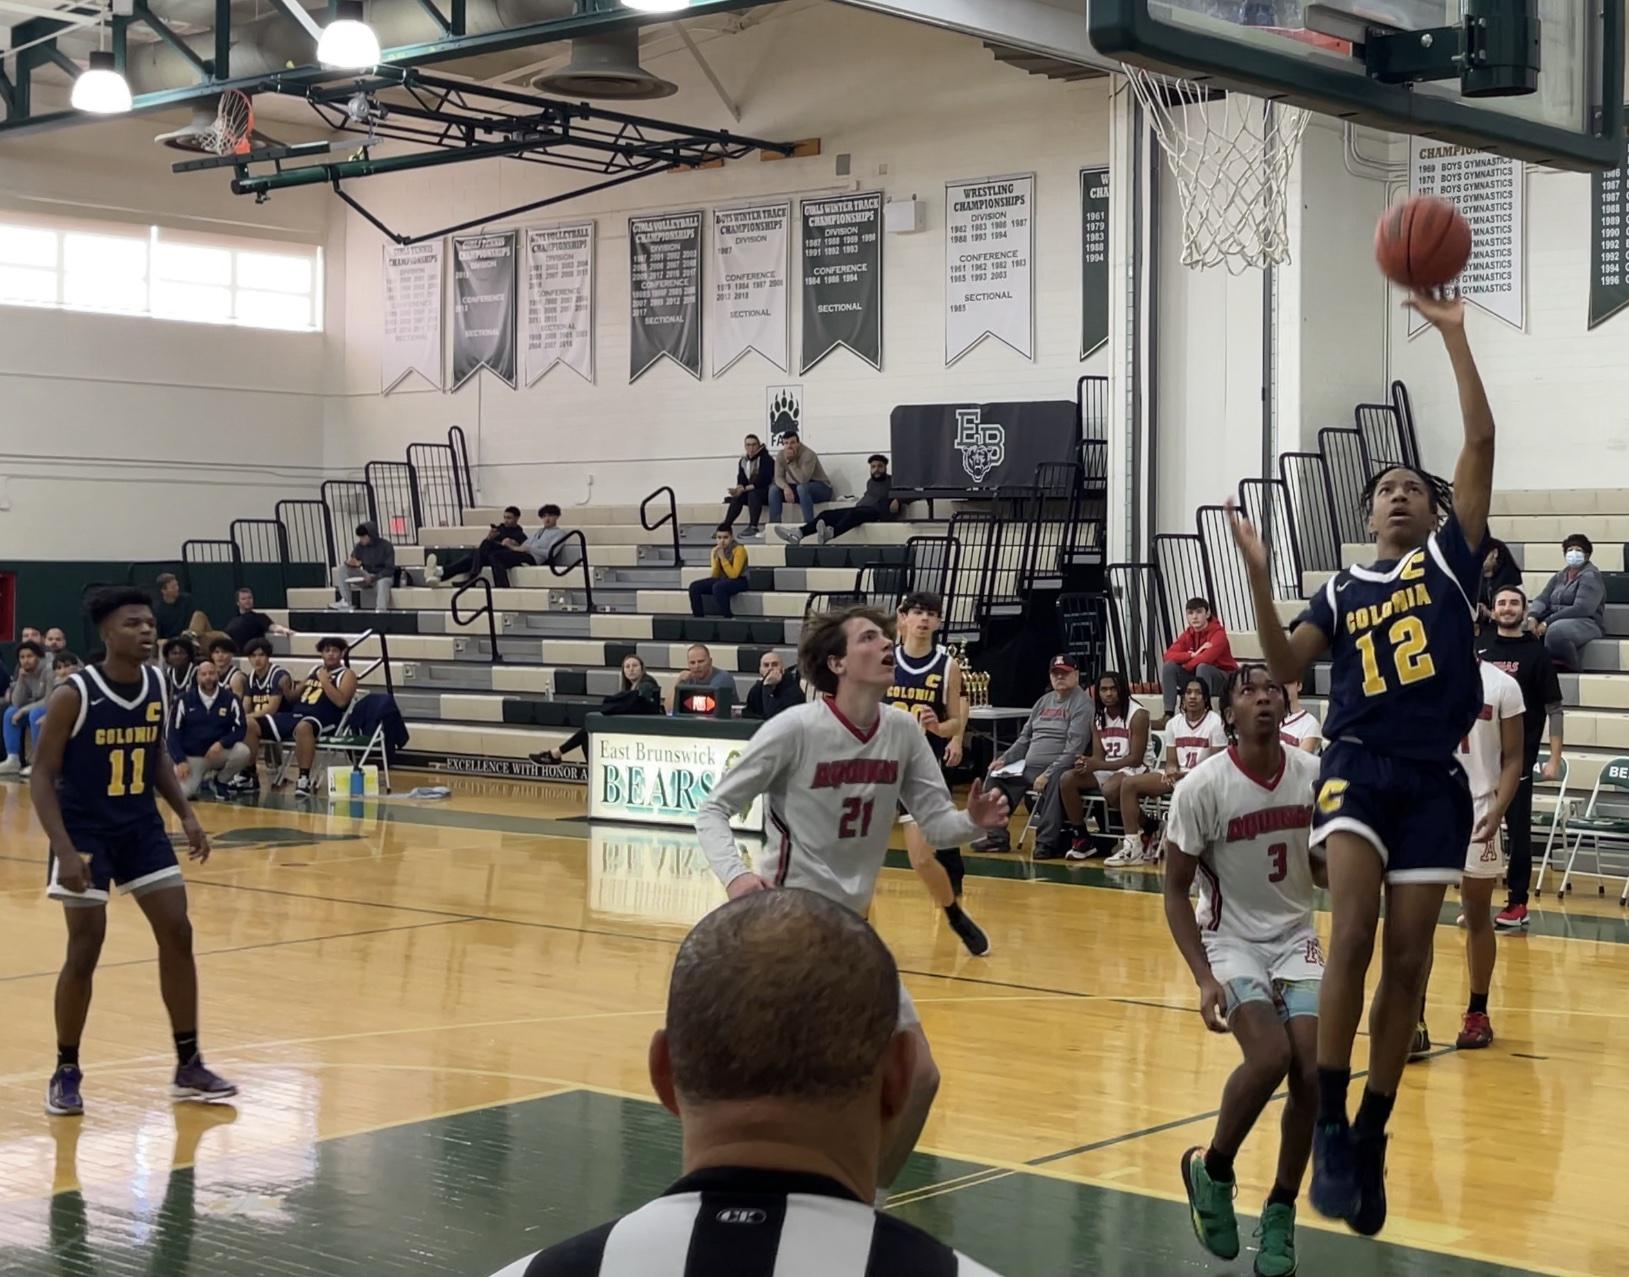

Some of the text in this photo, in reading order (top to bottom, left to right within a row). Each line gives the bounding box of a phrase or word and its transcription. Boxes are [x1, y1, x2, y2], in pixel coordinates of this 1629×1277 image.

[1419, 165, 1435, 173] 1969
[1441, 162, 1462, 172] BOYS
[1419, 167, 1512, 184] 1970 BOYS GYMNASTICS
[963, 184, 1014, 199] WRESTLING
[1440, 184, 1461, 194] BOYS
[1463, 179, 1512, 192] GYMNASTICS
[1602, 180, 1620, 190] 1987
[1463, 190, 1512, 203] GYMNASTICS
[1602, 192, 1620, 202] 1987
[804, 198, 879, 216] GIRLS WINTER TRACK
[954, 195, 1025, 212] CHAMPIONSHIPS
[1462, 202, 1512, 215] GYMNASTICS
[733, 210, 762, 222] WINTER
[762, 208, 786, 219] TRACK
[809, 211, 874, 227] CHAMPIONSHIPS
[971, 211, 1007, 222] DIVISION
[1086, 211, 1105, 220] 1961
[1468, 213, 1512, 225] YMNASTICS
[653, 217, 698, 232] VOLLEYBALL
[720, 220, 782, 235] CHAMPIONSHIPS
[1086, 222, 1105, 231] 1979
[547, 228, 589, 242] VOLLEYBALL
[636, 228, 695, 243] CHAMPIONSHIPS
[825, 226, 858, 237] DIVISION
[1601, 228, 1620, 237] 1990
[532, 239, 587, 253] CHAMPIONSHIPS
[735, 235, 767, 245] DIVISION
[1601, 240, 1620, 249] 1992
[959, 250, 1018, 262] CONFERENCE
[1086, 253, 1104, 262] 1994
[1601, 251, 1620, 261] 1992
[814, 263, 867, 275] CONFERENCE
[1601, 263, 1619, 273] 1994
[725, 271, 775, 282] CONFERENCE
[1462, 272, 1512, 283] GYMNASTICS
[641, 278, 689, 289] CONFERENCE
[1462, 283, 1512, 294] GYMNASTICS
[964, 291, 1013, 302] SECTIONAL
[730, 309, 771, 318] SECTIONAL
[818, 303, 862, 312] SECTIONAL
[645, 315, 684, 325] SECTIONAL
[1400, 552, 1425, 581] C
[1346, 583, 1432, 635] COLONIA
[1355, 615, 1436, 698] 12
[925, 674, 942, 689] C
[886, 685, 936, 703] COLONIA
[146, 702, 161, 721] C
[600, 739, 716, 766] East Brunswick
[1106, 742, 1122, 759] 22
[107, 748, 145, 796] 11
[446, 758, 510, 774] EXCELLENCE
[511, 763, 539, 776] WITH
[541, 765, 578, 779] HONOR
[1609, 766, 1629, 779] BE
[601, 763, 714, 810] BEARS
[1317, 777, 1347, 815] C
[838, 796, 875, 839] 21
[1267, 842, 1288, 883] 3
